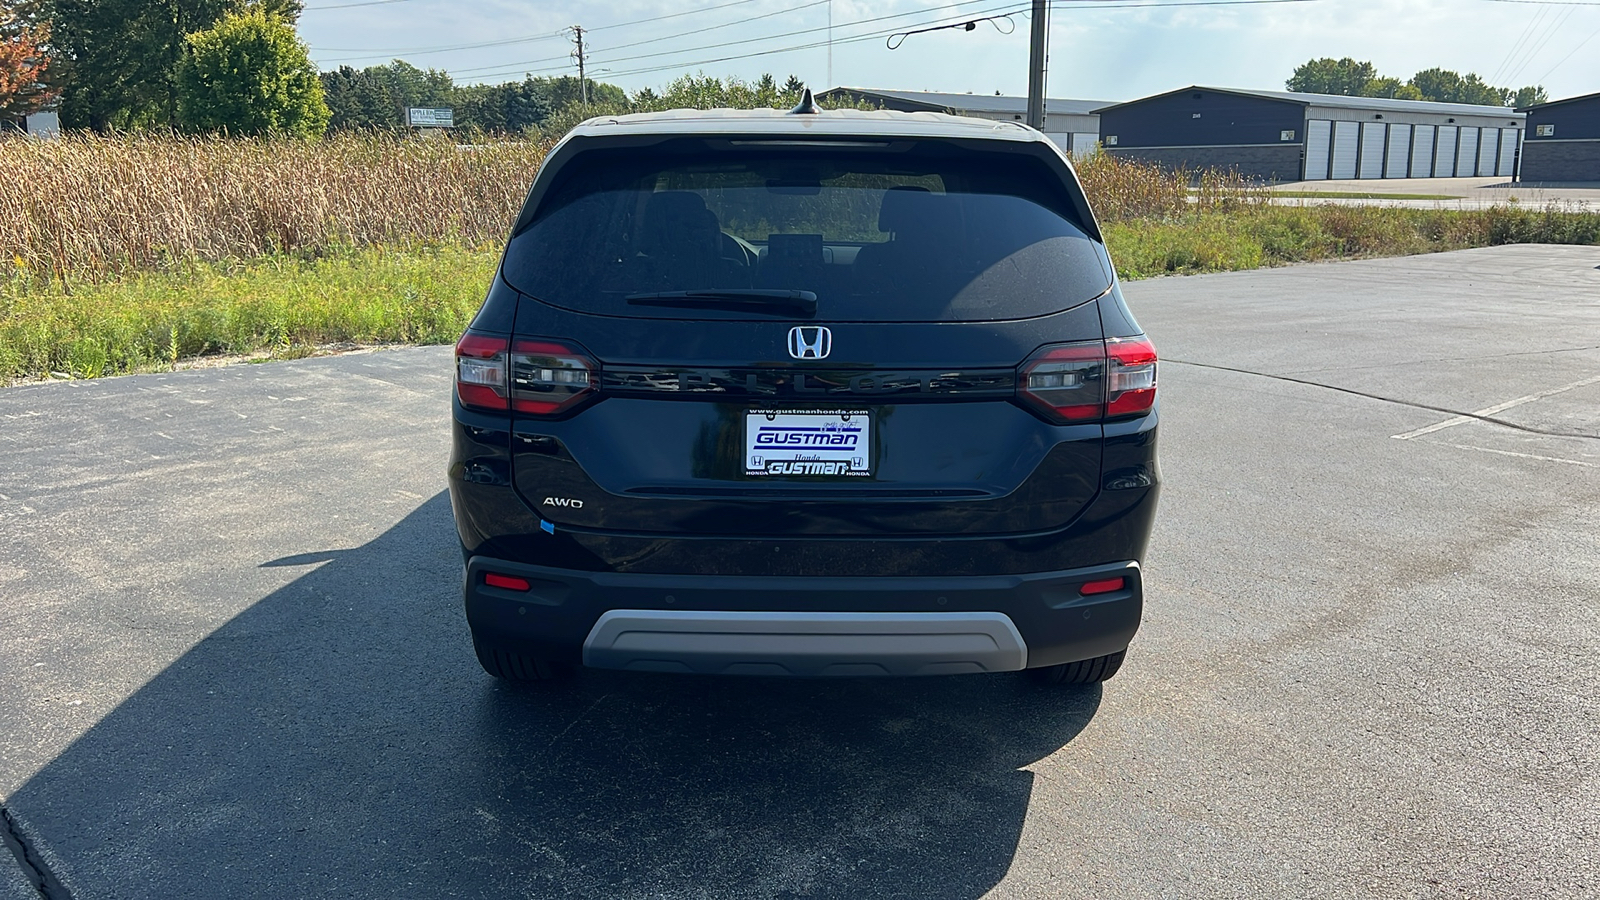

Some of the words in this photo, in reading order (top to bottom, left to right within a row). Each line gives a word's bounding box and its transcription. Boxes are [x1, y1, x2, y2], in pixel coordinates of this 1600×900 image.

[677, 373, 939, 394] PILOT
[794, 453, 821, 461] Honda
[542, 496, 584, 509] AWD
